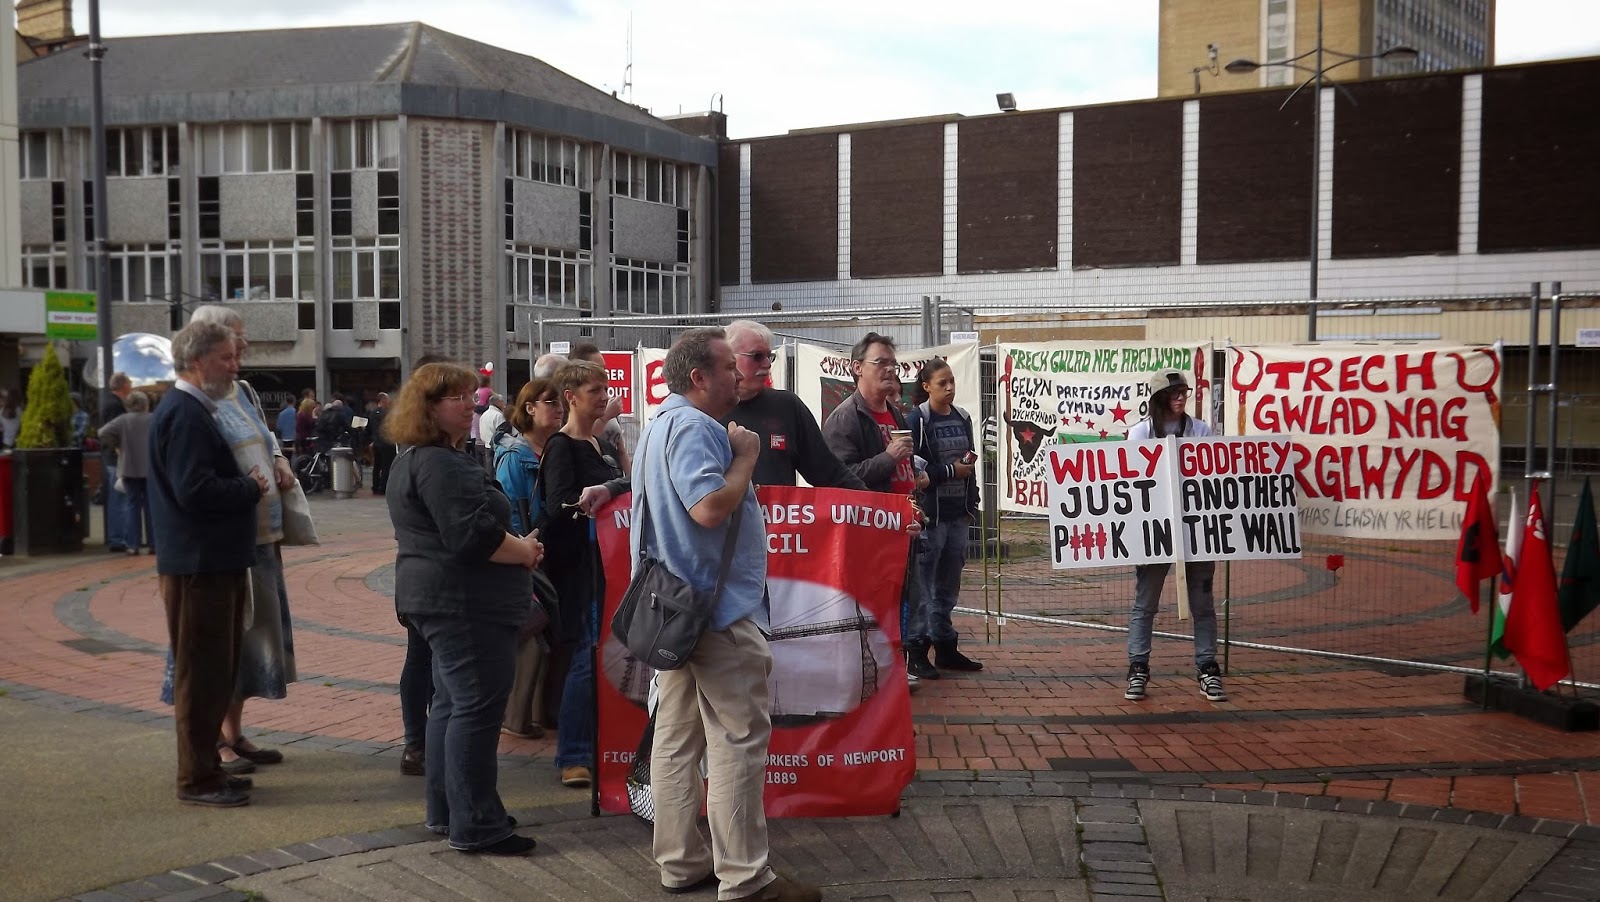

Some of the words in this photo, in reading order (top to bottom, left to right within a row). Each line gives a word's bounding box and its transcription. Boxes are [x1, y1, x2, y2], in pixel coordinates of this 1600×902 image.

[820, 355, 853, 378] CYMR
[1010, 348, 1050, 372] TRECH
[1050, 349, 1092, 374] GWLAD
[1092, 348, 1119, 374] NAG
[1121, 347, 1192, 373] ARGLWYDD
[1265, 351, 1438, 393] TRECH
[607, 386, 629, 399] OUT
[1011, 376, 1053, 398] GELYN
[1057, 400, 1105, 415] CYMRU
[1253, 394, 1377, 435] GWLAD
[1385, 397, 1469, 442] NAG
[1049, 444, 1163, 485] WILLY
[1179, 441, 1291, 477] GODFREY
[1060, 480, 1157, 519] JUST
[1183, 474, 1297, 513] ANOTHER
[831, 504, 901, 531] UNION
[1334, 505, 1389, 531] LEWSYN
[1394, 509, 1412, 530] YR
[1142, 518, 1173, 557] IN
[1182, 513, 1236, 555] THE
[1241, 512, 1301, 554] WALL
[817, 753, 837, 767] OF
[843, 748, 906, 767] NEWPORT
[766, 771, 797, 784] 1889
